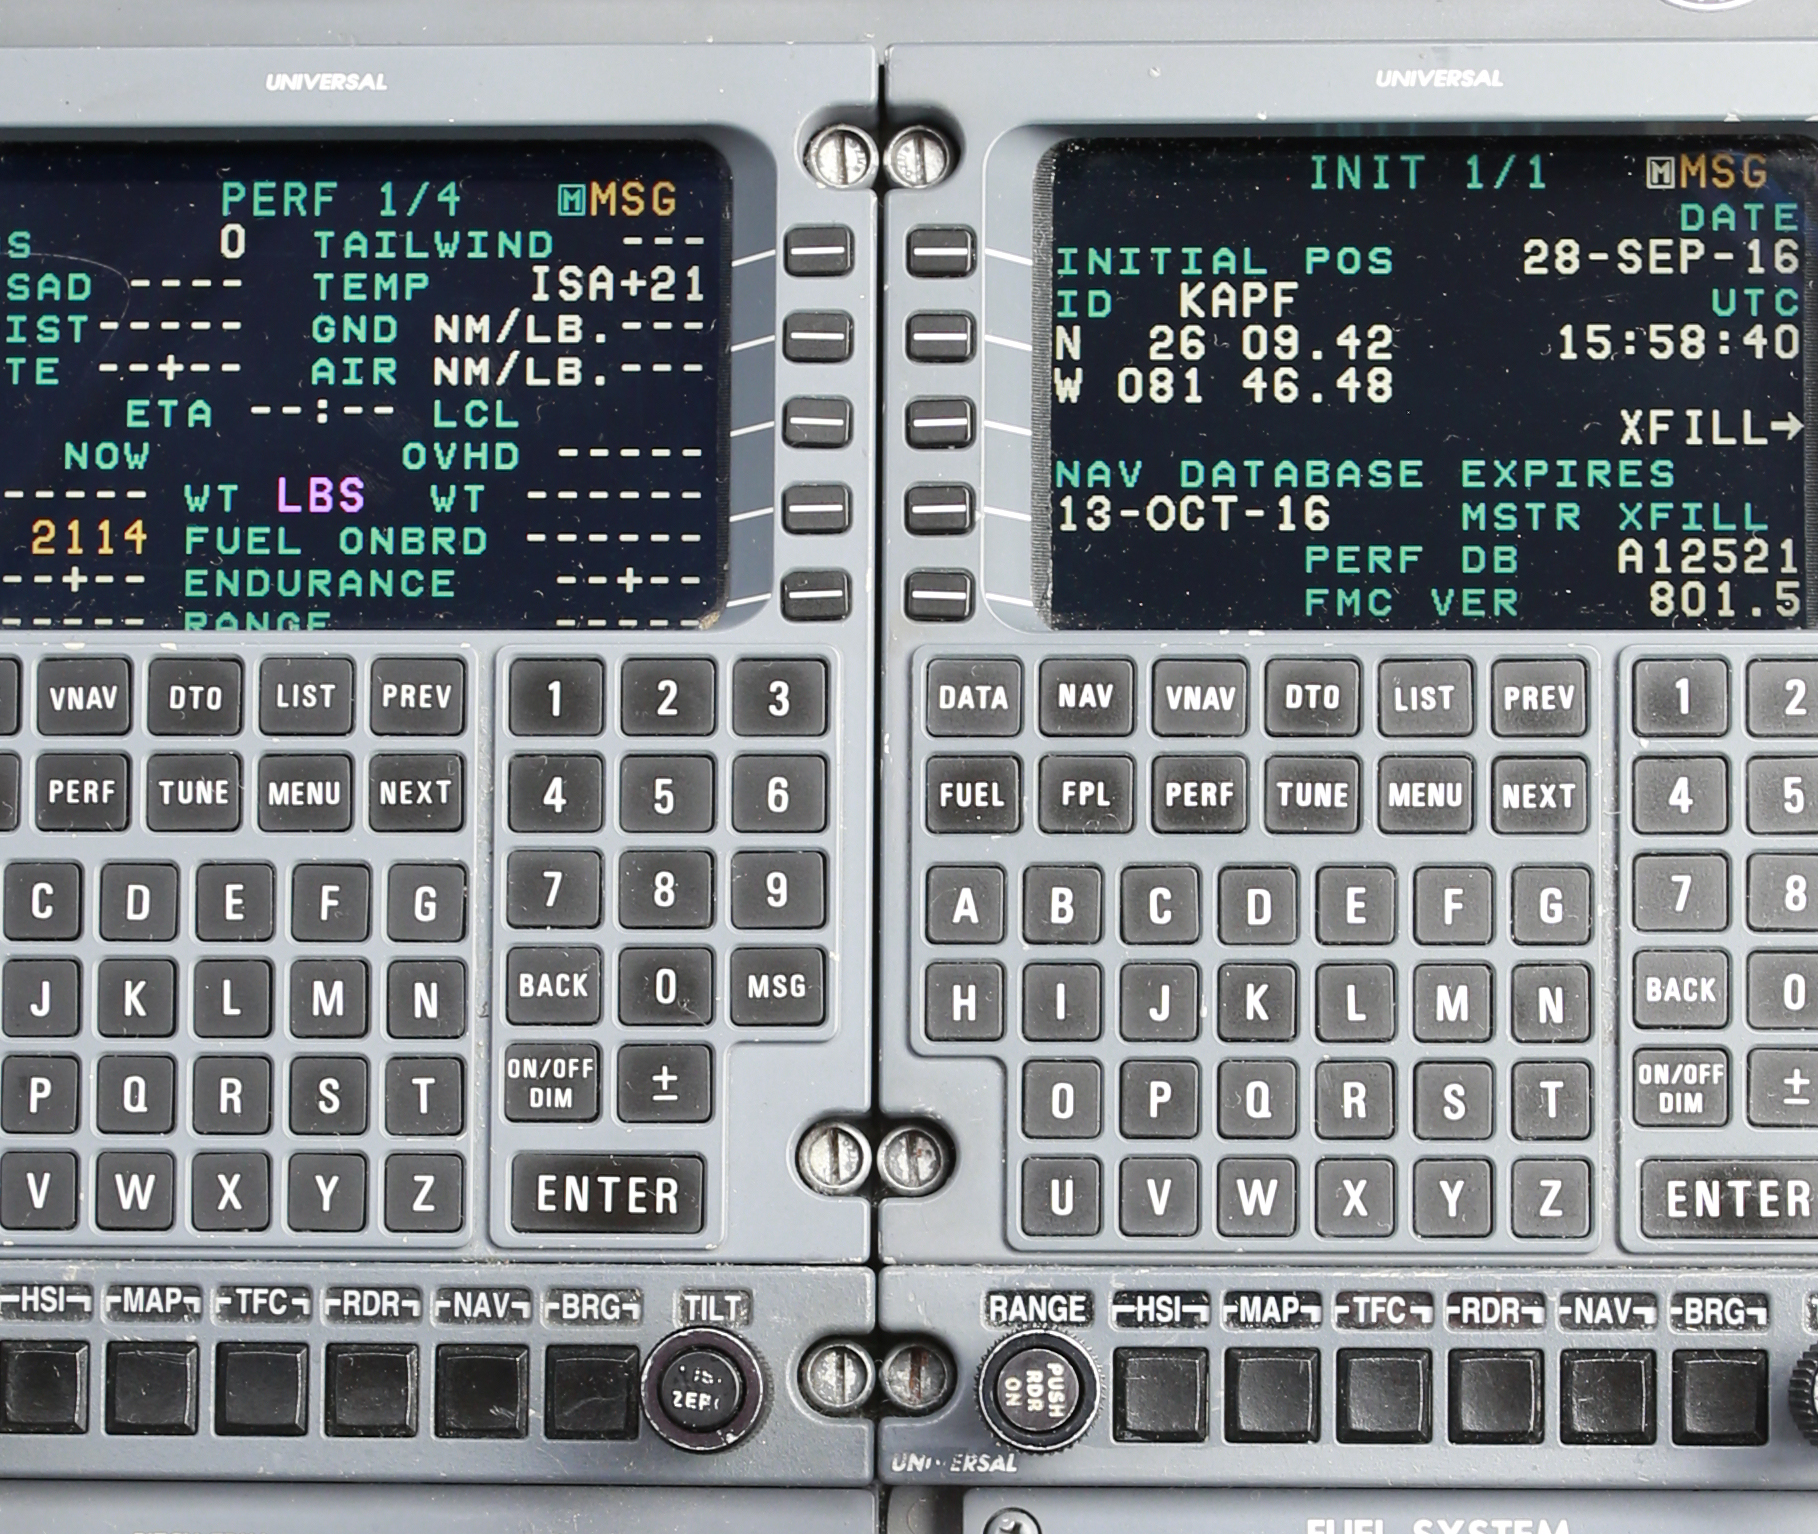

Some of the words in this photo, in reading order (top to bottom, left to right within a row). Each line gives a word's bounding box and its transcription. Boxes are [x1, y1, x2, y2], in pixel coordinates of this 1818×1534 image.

[266, 74, 387, 90] UNIVERSAL
[1376, 70, 1503, 87] UNIVERSAL
[1311, 155, 1425, 189] INIT
[1467, 155, 1545, 189] 1/1
[1681, 154, 1769, 189] MSG
[223, 181, 337, 216] PERF
[381, 182, 460, 216] 1/4
[590, 182, 675, 216] MSG
[1681, 203, 1798, 231] DATE
[314, 231, 552, 258] TAILWIND
[1058, 247, 1267, 277] INITIAL
[1306, 247, 1392, 274] POS
[1524, 239, 1798, 274] 28-SEP-16
[314, 273, 429, 300] TEMP
[532, 266, 703, 301] ISA+21
[1057, 290, 1112, 317] ID
[1181, 282, 1298, 317] KAPF
[1712, 289, 1798, 316] UTC
[313, 313, 397, 343] GND
[1150, 325, 1205, 360] 26
[1243, 325, 1392, 360] 09.42
[1560, 325, 1798, 359] 15:58:40
[312, 358, 396, 385] AIR
[1118, 368, 1202, 403] 081
[1243, 367, 1392, 403] 46.48
[127, 400, 211, 427] ETA
[434, 400, 519, 427] LCL
[1621, 410, 1768, 444] XFILL
[65, 442, 149, 469] NOW
[403, 442, 519, 469] OVHD
[1056, 461, 1142, 487] NAV
[1181, 460, 1423, 487] DATABASE
[1462, 460, 1674, 487] EXPIRES
[185, 485, 238, 512] WT
[277, 476, 365, 513] LBS
[1060, 495, 1329, 531] 13-OCT-16
[1462, 503, 1580, 530] MSTR
[1619, 502, 1769, 531] XFILL
[32, 520, 147, 554] 2114
[186, 526, 301, 554] FUEL
[340, 527, 486, 555] ONBRD
[1306, 546, 1422, 573] PERF
[1462, 546, 1517, 573] DB
[1617, 538, 1798, 574] A12521
[184, 569, 456, 597] ENDURANCE
[1306, 589, 1392, 616] FMC
[1431, 589, 1517, 616] VER
[1650, 581, 1800, 616] 801.5
[50, 686, 117, 710] VNAV
[383, 684, 451, 708] PREV
[549, 681, 560, 716] 1
[940, 686, 1008, 709] DATA
[1505, 685, 1574, 710] PREV
[50, 780, 114, 803] PERF
[269, 782, 339, 805] MENU
[381, 780, 451, 804] NEXT
[1503, 784, 1575, 808] NEXT
[538, 1175, 677, 1213] ENTER
[1668, 1180, 1810, 1217] ENTER
[20, 1289, 64, 1313] HSI
[123, 1289, 182, 1313] MAP
[235, 1289, 288, 1314] TFC
[343, 1292, 400, 1317] RDR
[453, 1293, 511, 1318] NAV
[563, 1293, 621, 1319] BRG
[686, 1295, 740, 1321] TILT
[989, 1294, 1086, 1321] RANGE
